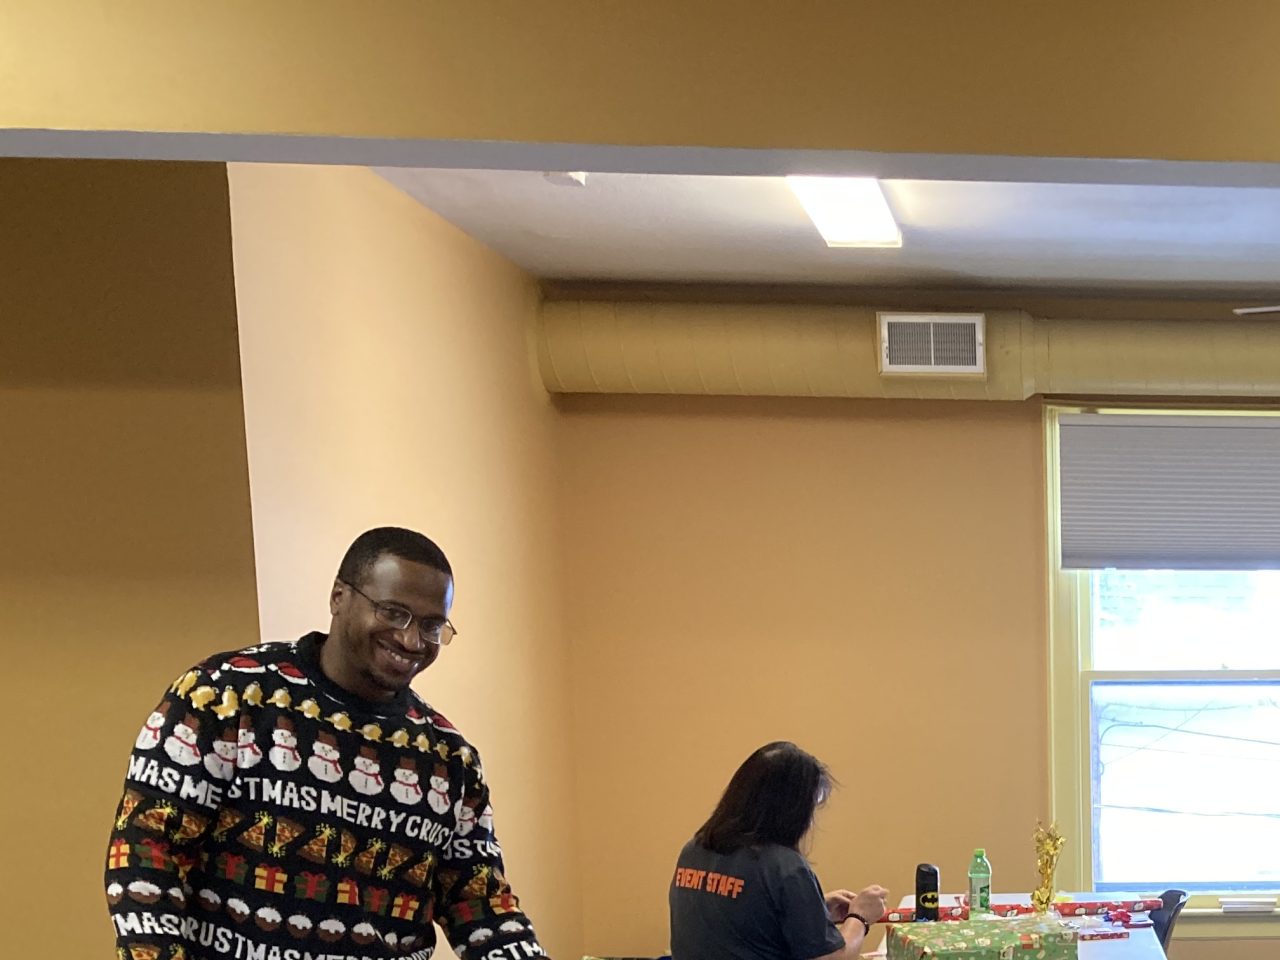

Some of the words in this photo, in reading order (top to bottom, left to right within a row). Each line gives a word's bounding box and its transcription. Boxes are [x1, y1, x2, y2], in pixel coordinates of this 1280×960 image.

[127, 754, 181, 794] MAS
[320, 789, 406, 834] MERRY
[675, 867, 707, 890] EVENT
[706, 871, 745, 899] STAFF
[112, 911, 180, 938] MAS
